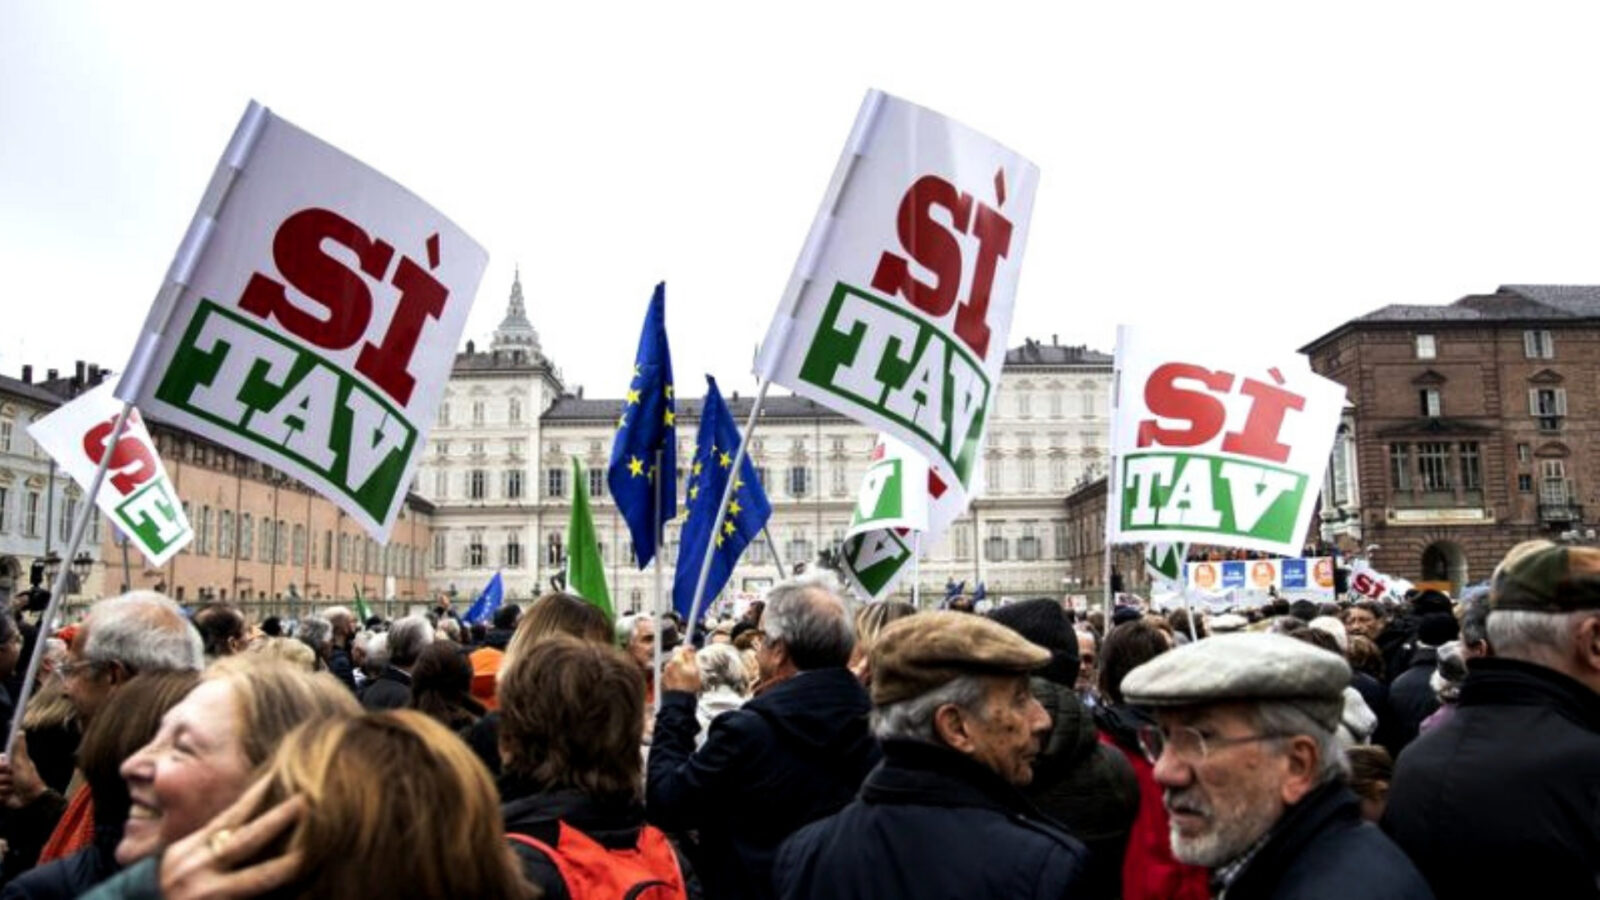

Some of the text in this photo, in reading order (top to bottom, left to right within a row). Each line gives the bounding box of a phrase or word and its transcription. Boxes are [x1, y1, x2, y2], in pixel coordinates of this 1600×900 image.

[237, 207, 450, 407] SÌ
[869, 166, 1014, 362] SÌ
[187, 309, 409, 493] TAV
[829, 291, 987, 461] TAV
[1136, 362, 1306, 464] SÌ
[1125, 456, 1299, 533] TAV
